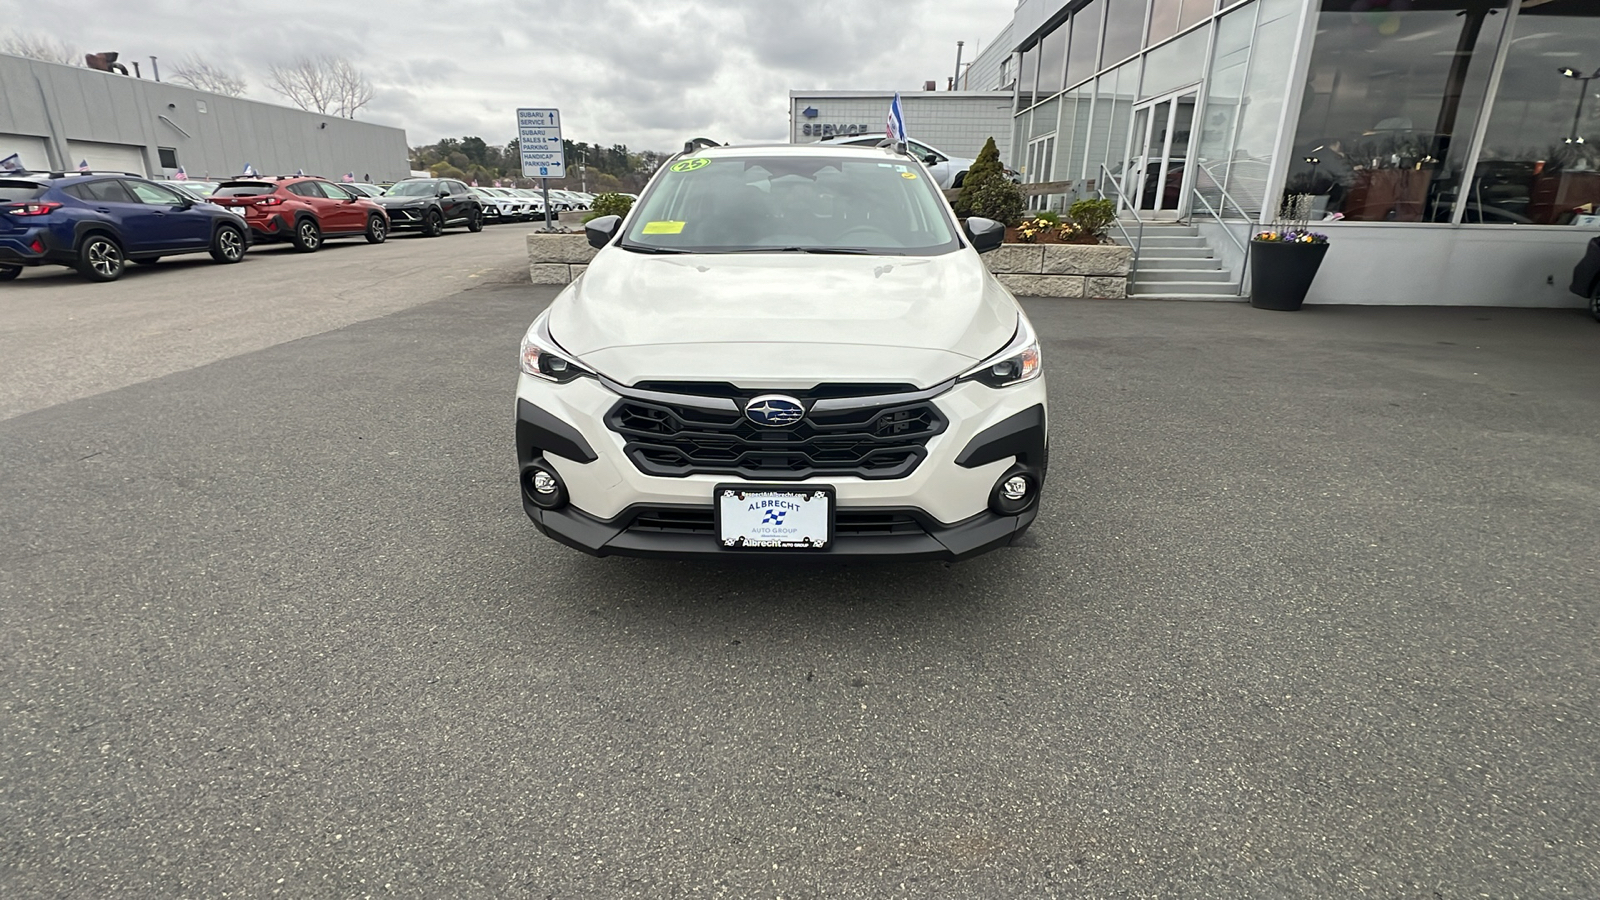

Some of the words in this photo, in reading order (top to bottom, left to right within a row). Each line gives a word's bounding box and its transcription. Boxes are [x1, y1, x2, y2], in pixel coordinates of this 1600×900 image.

[802, 124, 868, 136] SERVICE
[678, 160, 702, 170] 25
[748, 500, 800, 512] ALBRECHT
